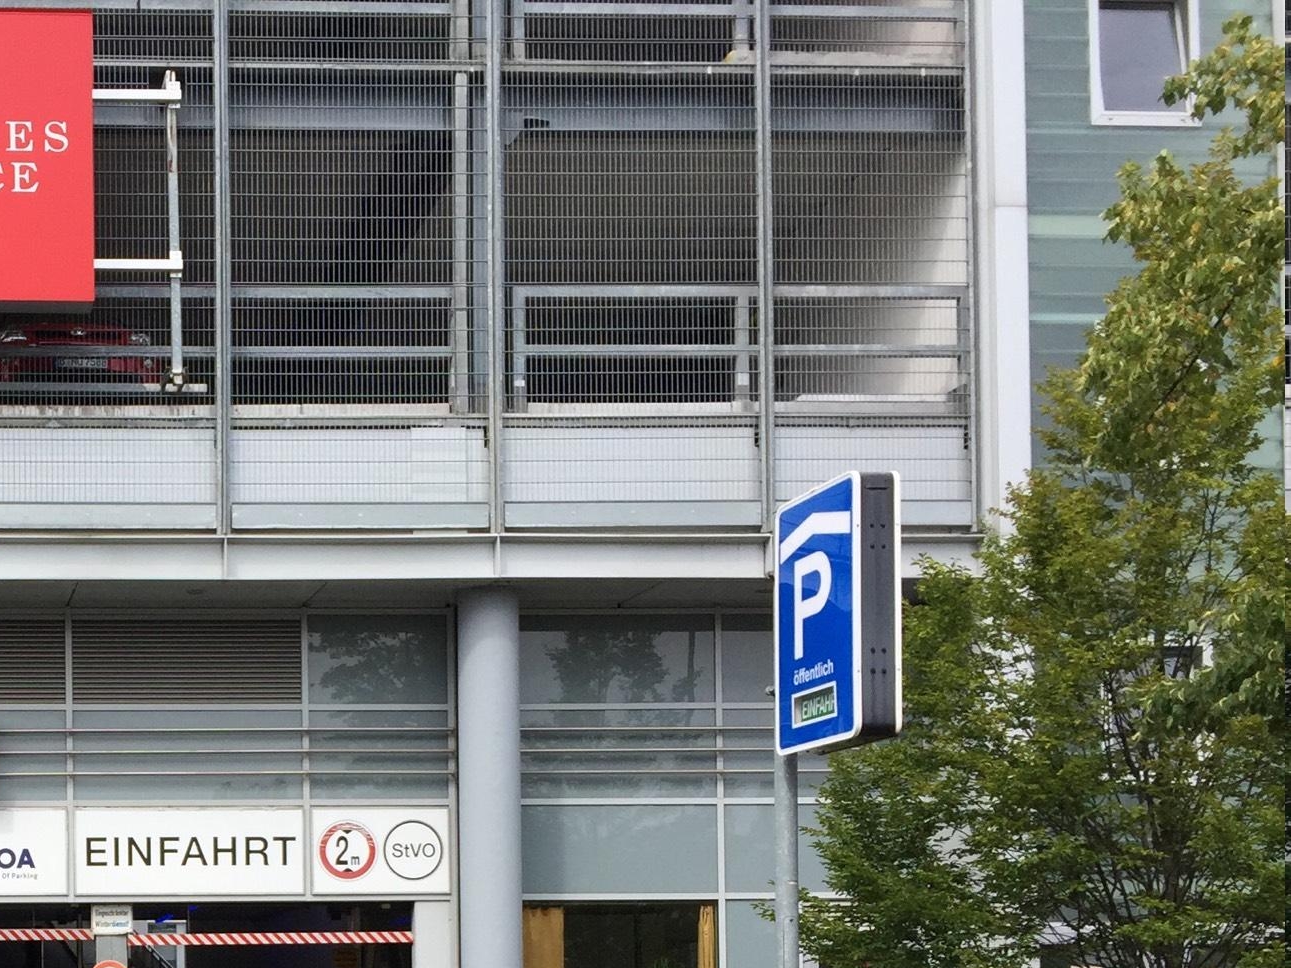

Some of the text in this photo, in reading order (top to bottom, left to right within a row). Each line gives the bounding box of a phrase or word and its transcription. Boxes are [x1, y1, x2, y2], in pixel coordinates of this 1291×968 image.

[793, 550, 832, 661] P
[793, 658, 835, 686] öffentlich
[84, 836, 297, 867] EINFAHRT
[391, 842, 436, 858] StVO
[2, 872, 10, 880] Of
[11, 872, 38, 881] Parking
